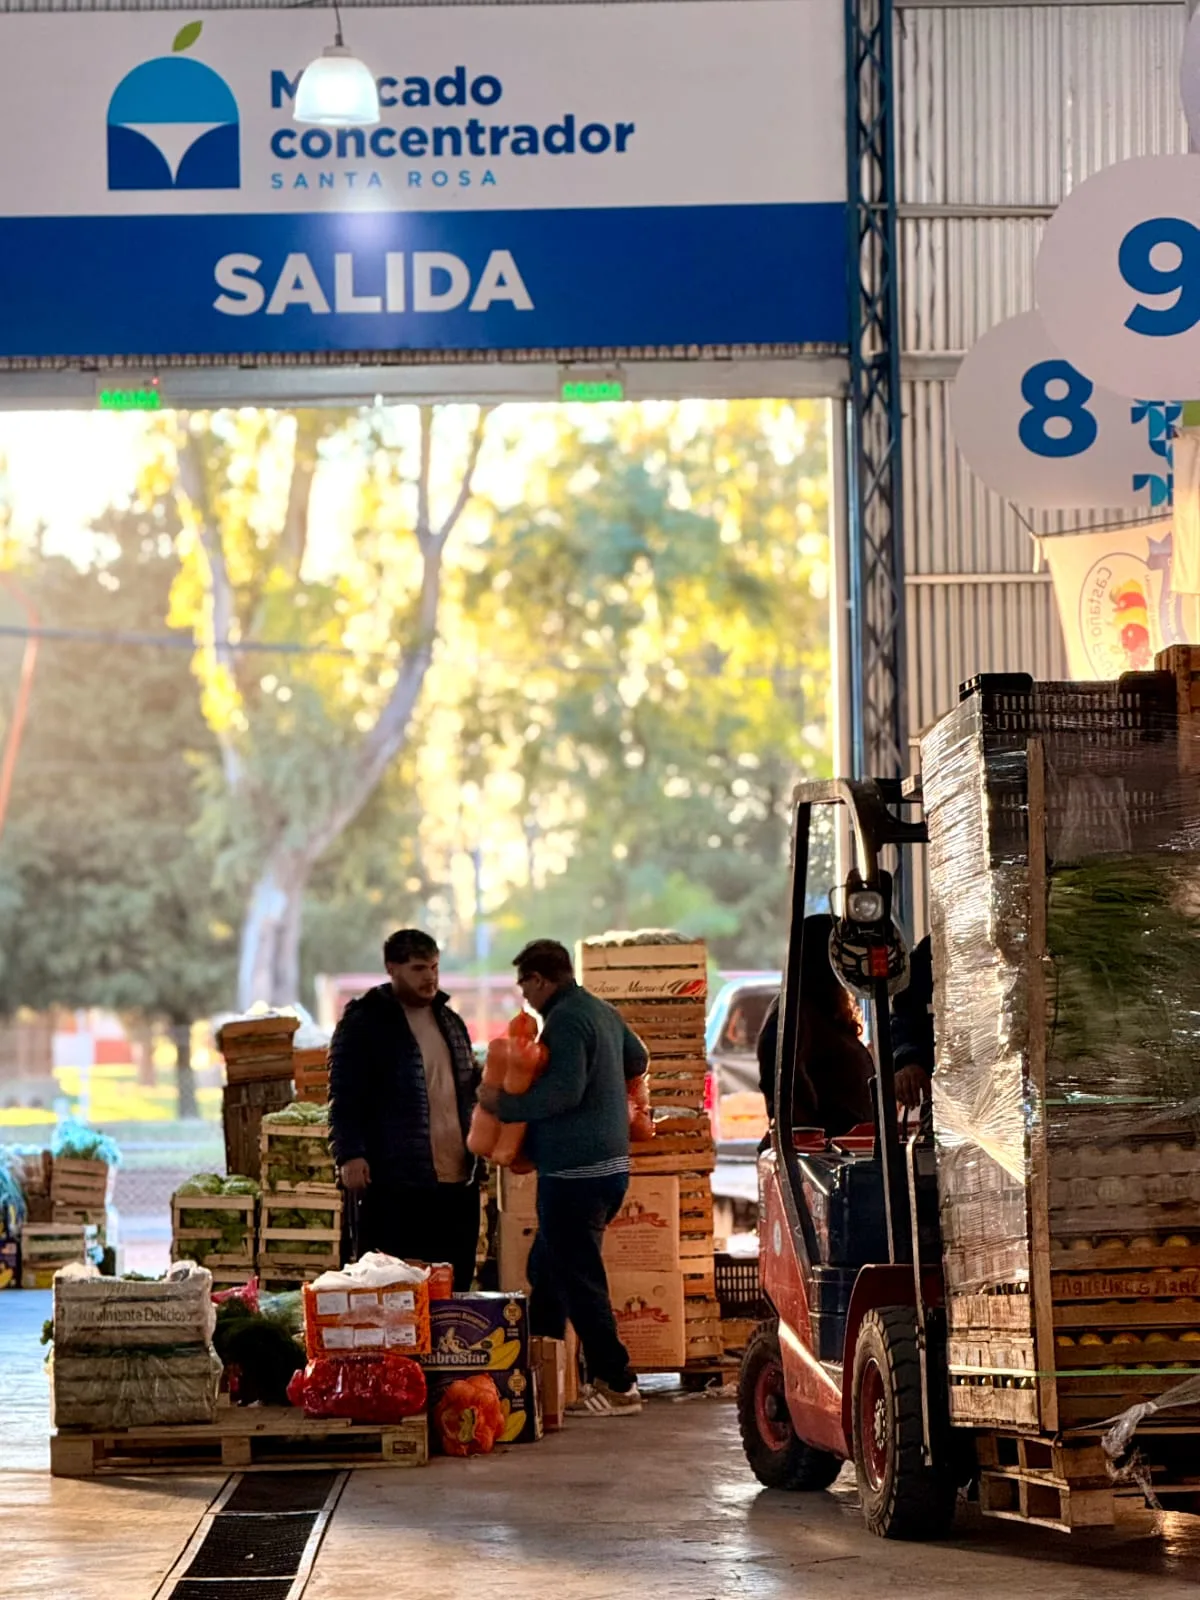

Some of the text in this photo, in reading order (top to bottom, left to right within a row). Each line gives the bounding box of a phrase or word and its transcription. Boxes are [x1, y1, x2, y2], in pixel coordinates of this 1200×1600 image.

[271, 66, 502, 108] Mcado
[271, 115, 635, 159] concentrador
[271, 170, 497, 189] SANTA ROSA
[213, 249, 534, 316] SALIDA
[1118, 217, 1200, 337] 9
[1019, 359, 1098, 458] 8
[420, 1351, 487, 1365] SabroStar
